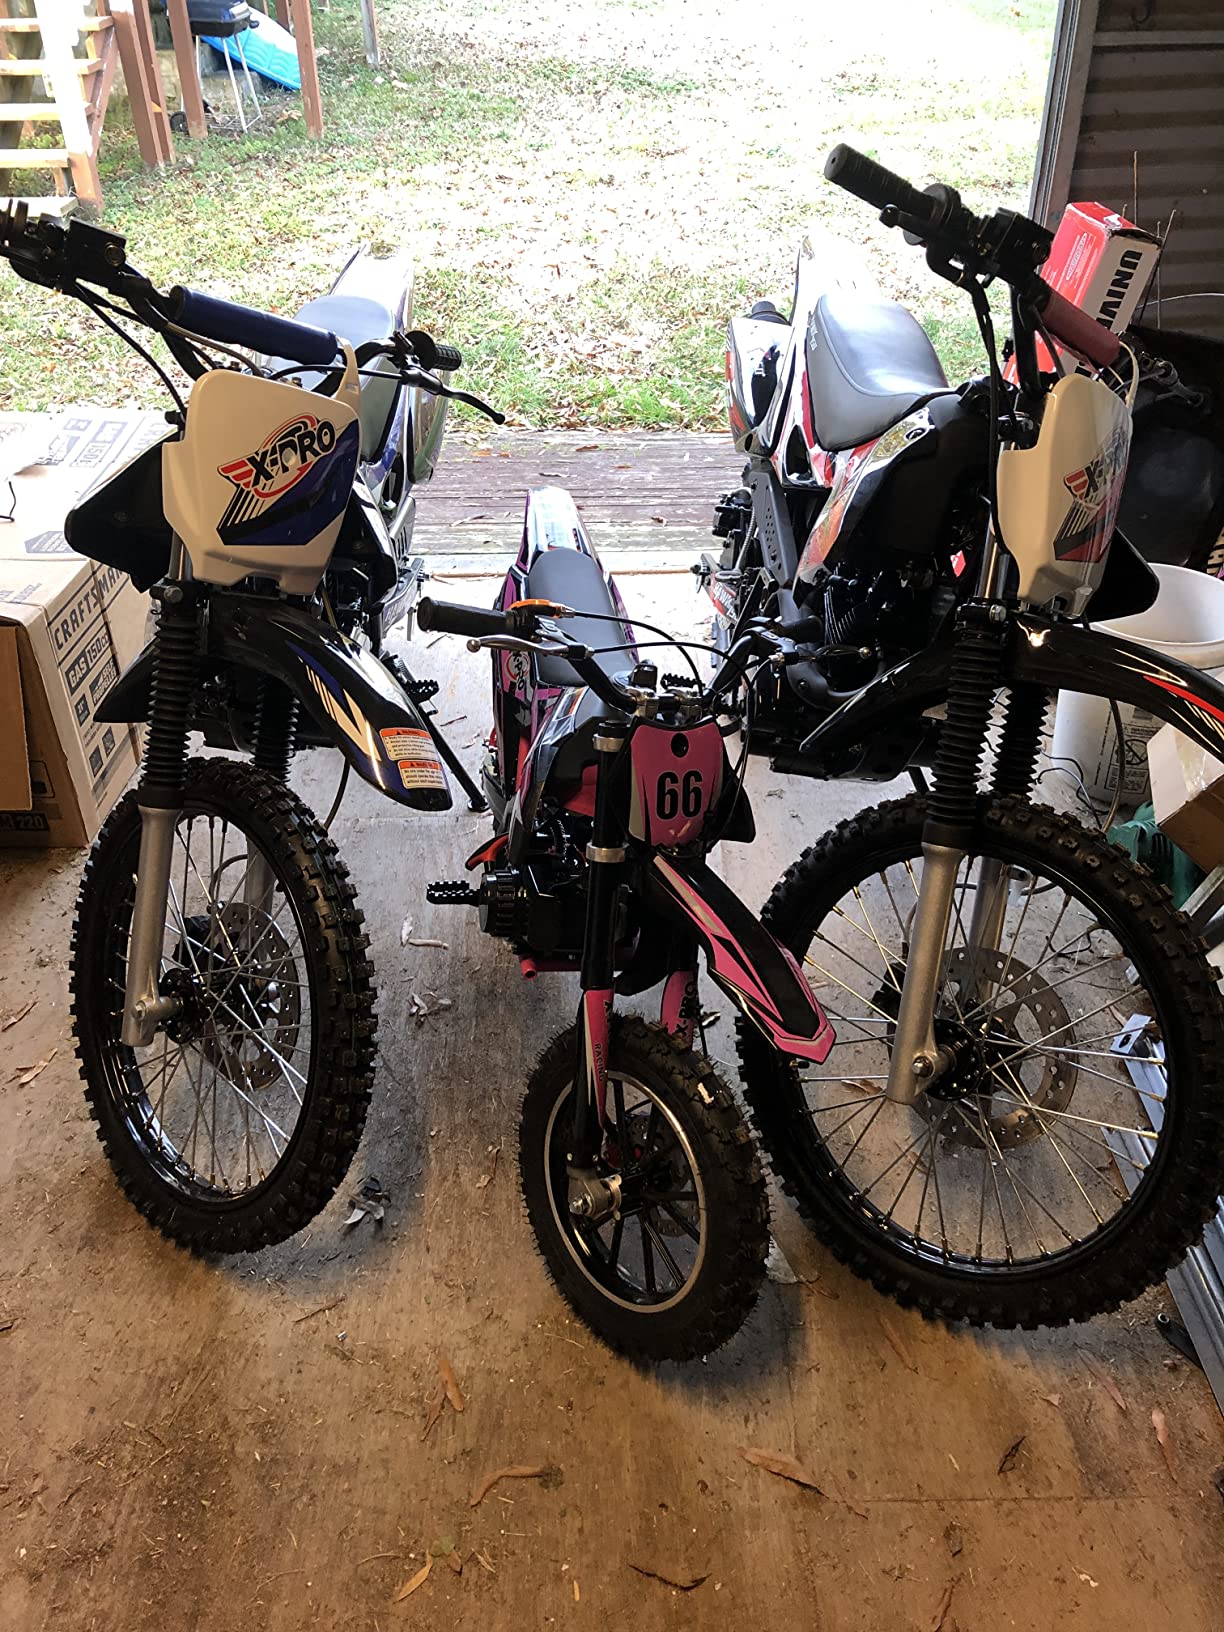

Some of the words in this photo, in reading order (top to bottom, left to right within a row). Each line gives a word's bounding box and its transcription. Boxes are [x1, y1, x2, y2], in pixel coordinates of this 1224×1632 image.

[246, 420, 336, 487] X-PRO
[68, 656, 88, 688] GAS
[656, 770, 703, 820] 66
